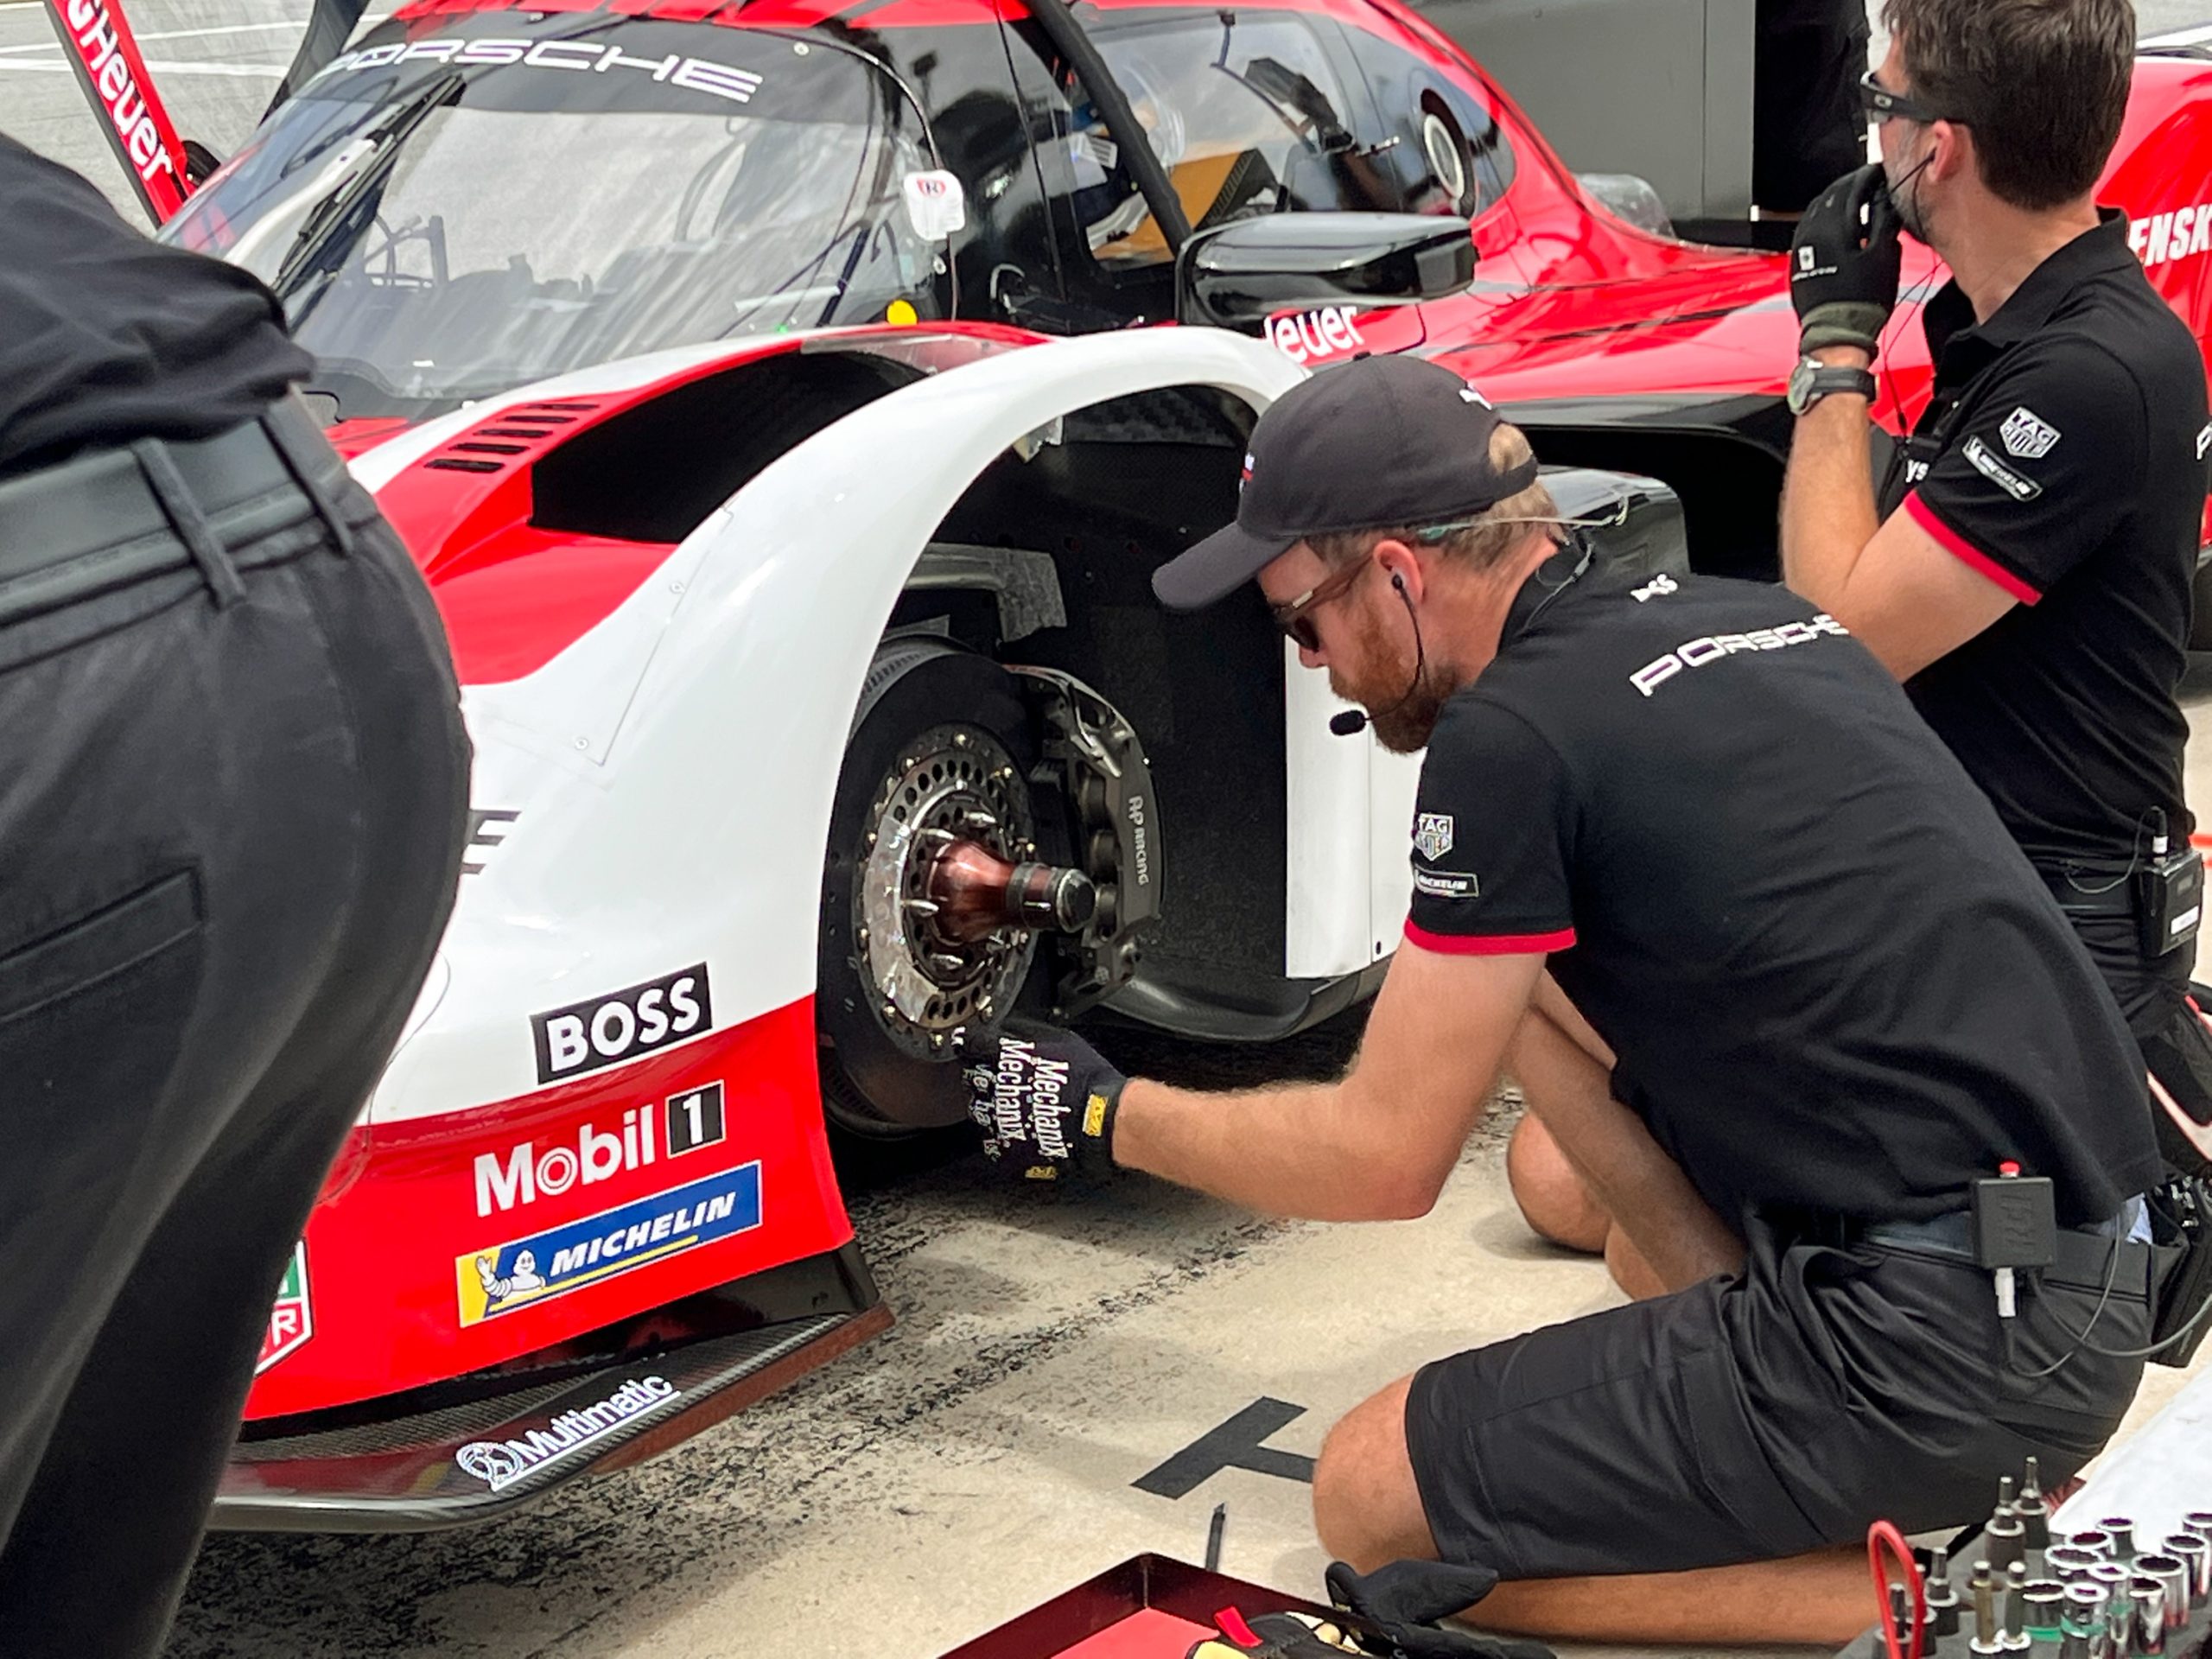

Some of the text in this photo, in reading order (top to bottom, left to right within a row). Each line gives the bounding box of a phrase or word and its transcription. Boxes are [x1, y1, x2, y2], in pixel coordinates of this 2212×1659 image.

[304, 38, 764, 103] PORSCHE
[2013, 410, 2057, 445] TAG
[1630, 613, 1850, 696] PORSCHE
[1418, 817, 1449, 833] TAG
[545, 976, 701, 1072] BOSS
[994, 1037, 1036, 1142] Mechanix
[1031, 1056, 1074, 1159] Mechanix
[474, 1092, 704, 1217] Mobil 1
[550, 1192, 736, 1277] MICHELIN
[505, 1376, 674, 1468] Multimatic
